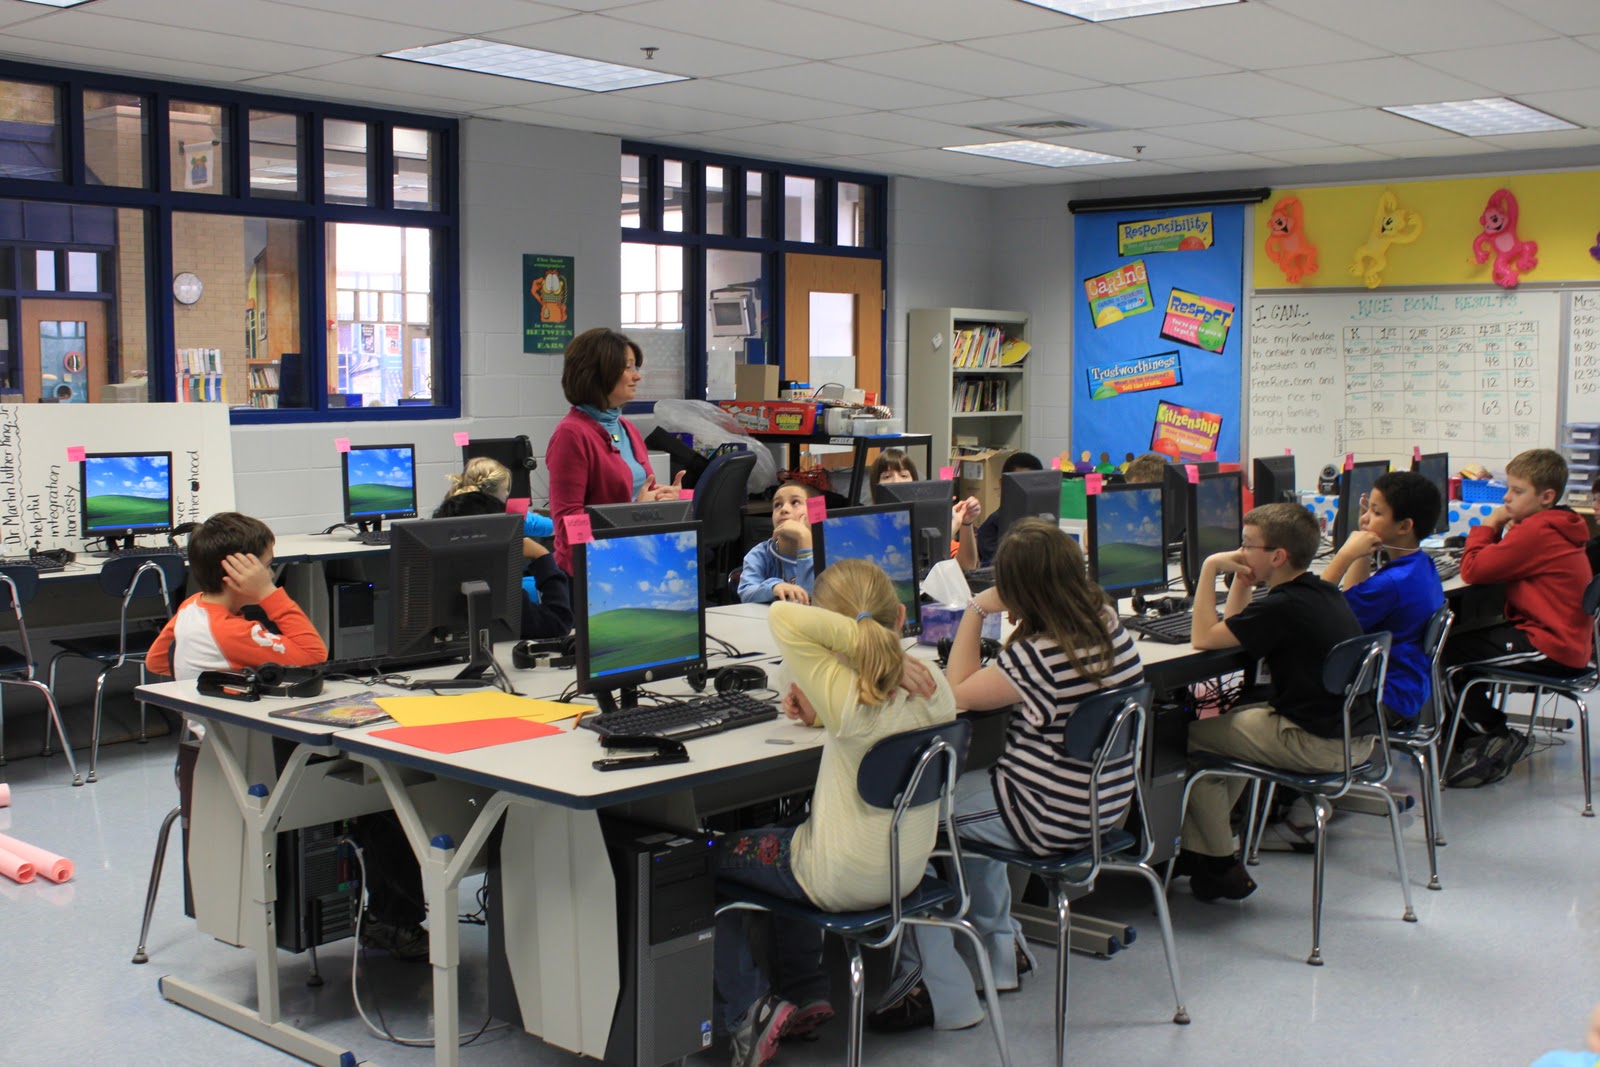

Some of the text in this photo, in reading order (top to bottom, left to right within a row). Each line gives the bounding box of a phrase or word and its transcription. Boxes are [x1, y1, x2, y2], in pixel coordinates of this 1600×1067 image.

[1124, 216, 1208, 240] Responsibility
[1255, 304, 1267, 322] I
[1358, 294, 1519, 317] RICE BOWL RESULTS
[1274, 335, 1289, 347] my
[1350, 327, 1361, 340] K
[1252, 348, 1262, 358] to
[1485, 356, 1500, 367] 48
[1091, 356, 1176, 380] Trustworthiness
[1304, 361, 1316, 370] on
[1513, 356, 1534, 368] 120
[1319, 375, 1335, 386] and
[1481, 377, 1500, 389] 112
[1513, 377, 1535, 388] 155
[1482, 399, 1502, 416] 63
[1514, 399, 1533, 417] 65
[1157, 405, 1220, 438] Citizenship
[0, 450, 14, 485] Luther
[2, 487, 20, 526] Martin
[45, 464, 65, 538] integration
[27, 494, 48, 538] helpful
[64, 485, 80, 538] honesty
[698, 931, 713, 941] DELL
